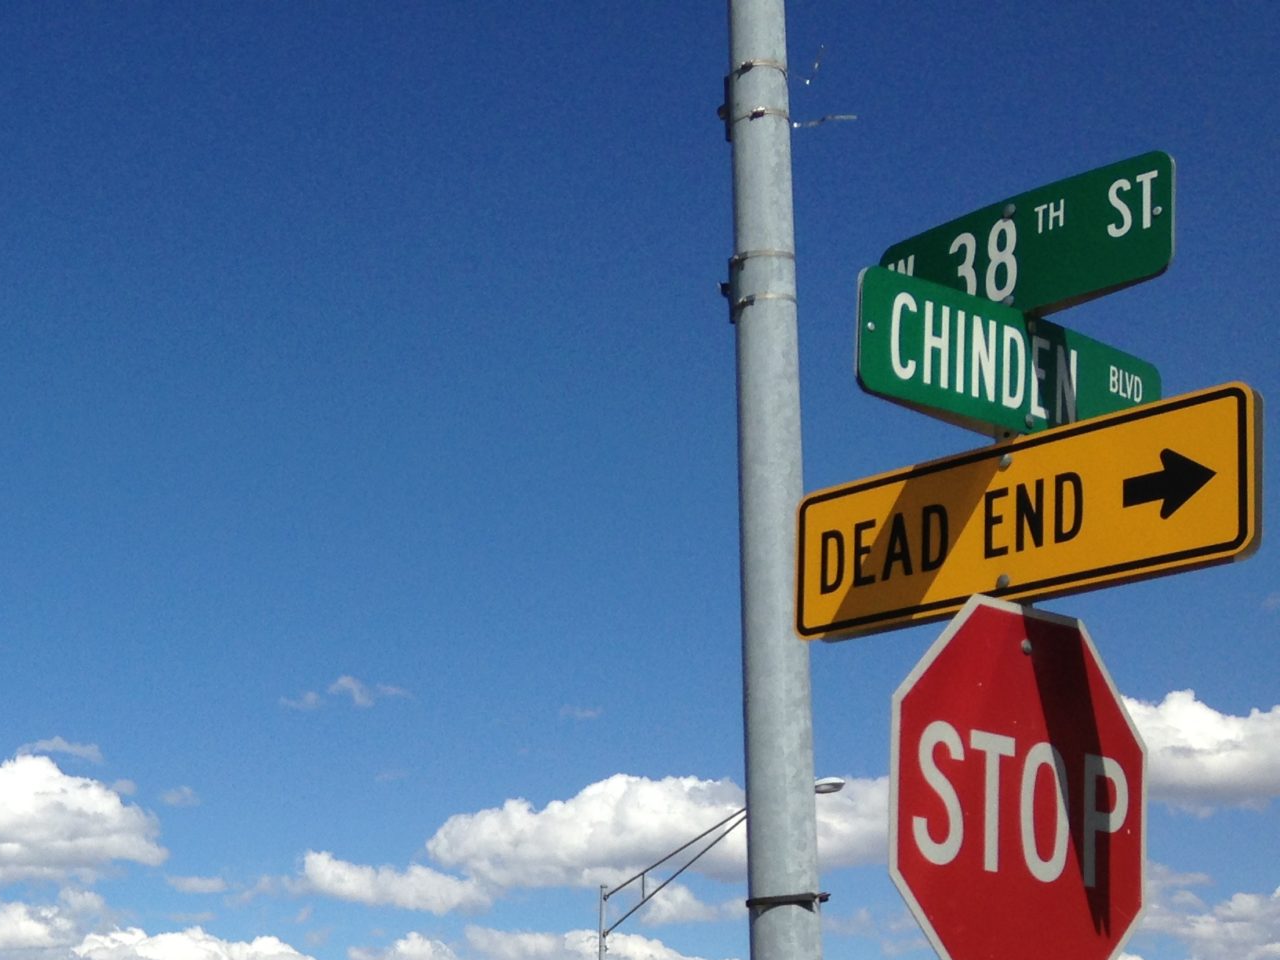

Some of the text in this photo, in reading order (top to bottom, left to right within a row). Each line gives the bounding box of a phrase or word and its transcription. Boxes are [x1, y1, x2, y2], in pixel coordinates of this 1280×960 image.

[948, 169, 1159, 302] 38 TH ST
[890, 291, 1143, 424] CHINDEN BLVD
[820, 471, 1084, 595] DEAD END
[912, 720, 1129, 888] STOP
